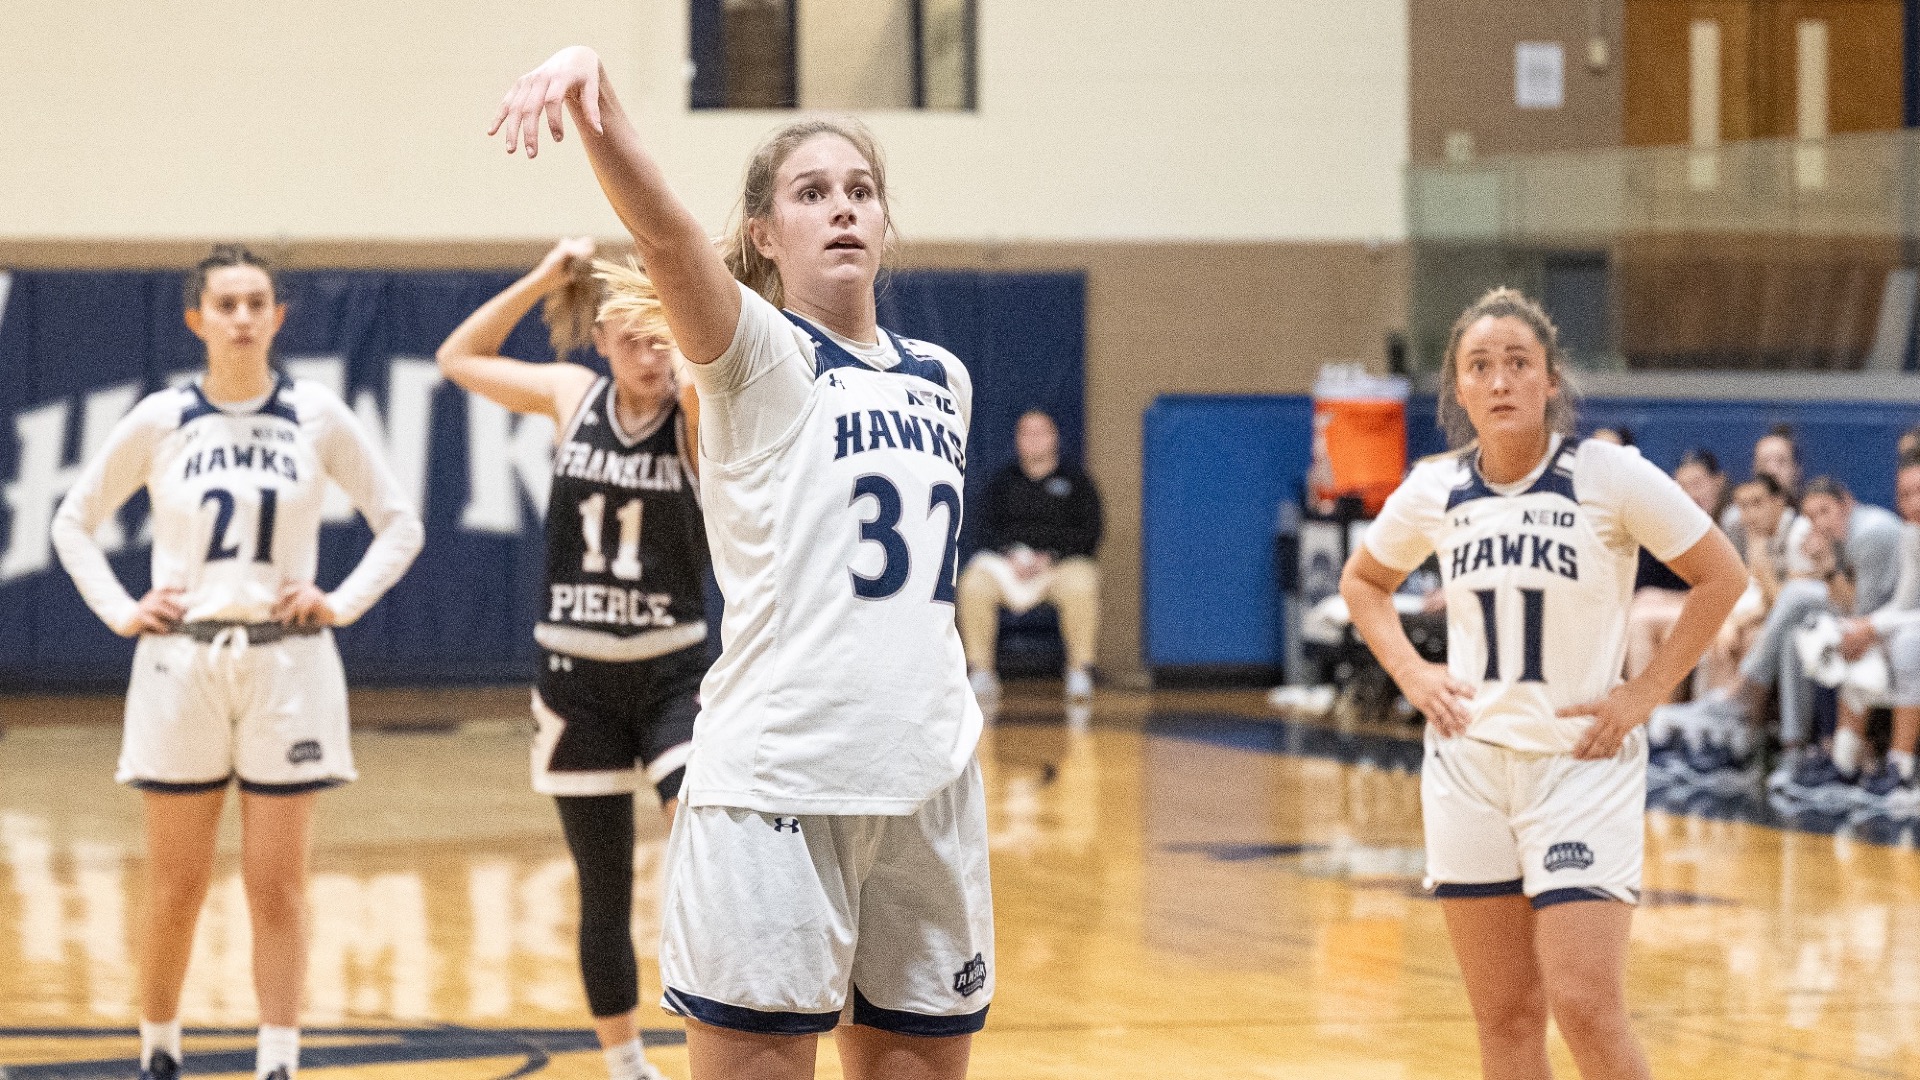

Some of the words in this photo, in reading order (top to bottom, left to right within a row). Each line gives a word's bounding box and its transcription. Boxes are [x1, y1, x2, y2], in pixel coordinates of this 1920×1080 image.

[183, 444, 298, 482] HAWKS
[556, 441, 682, 492] FRANKLIN
[833, 409, 964, 477] HAWKS
[199, 487, 278, 565] 21
[579, 492, 644, 582] 11
[847, 471, 962, 607] 32
[1450, 533, 1579, 581] HAWKS
[549, 584, 676, 627] PIERCE
[1469, 587, 1549, 684] 11
